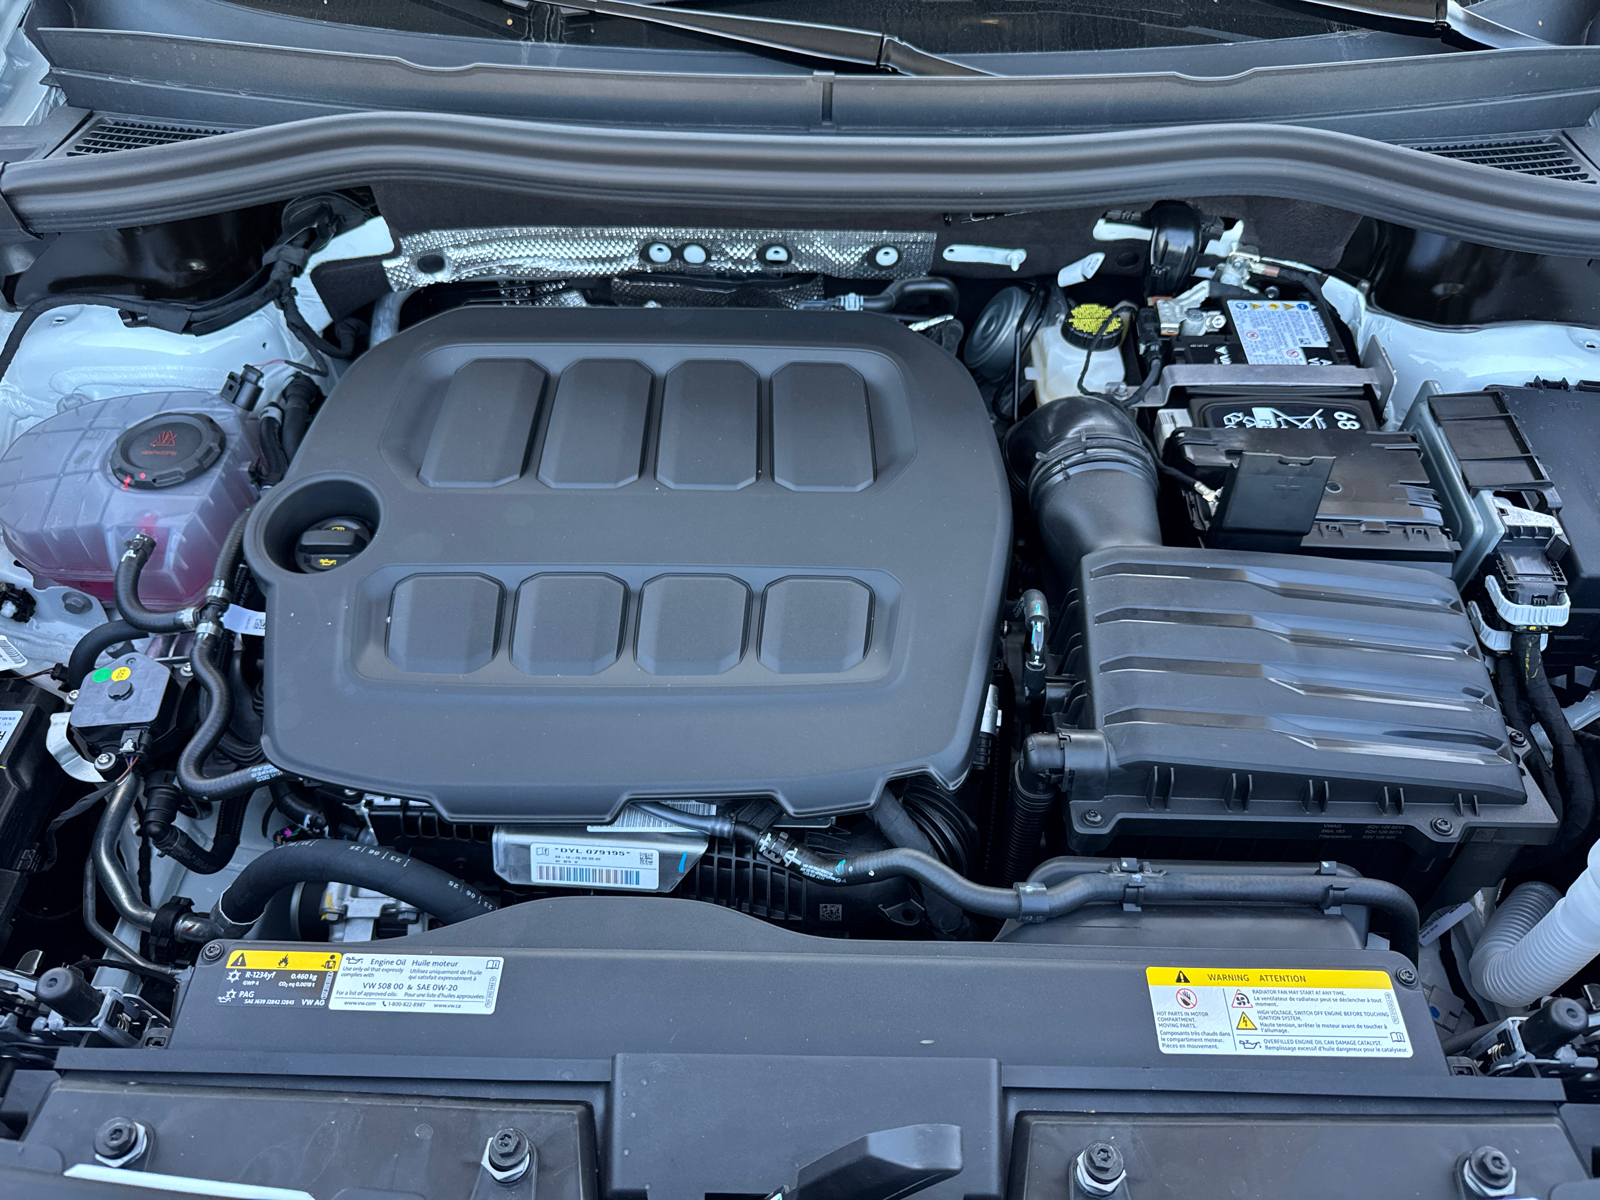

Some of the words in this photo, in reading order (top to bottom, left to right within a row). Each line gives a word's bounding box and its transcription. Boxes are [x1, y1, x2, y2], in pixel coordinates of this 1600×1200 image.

[370, 958, 394, 967] Engine
[245, 972, 276, 980] R-1234yf
[1207, 974, 1250, 982] WARNING
[1260, 974, 1306, 982] ATTENTION
